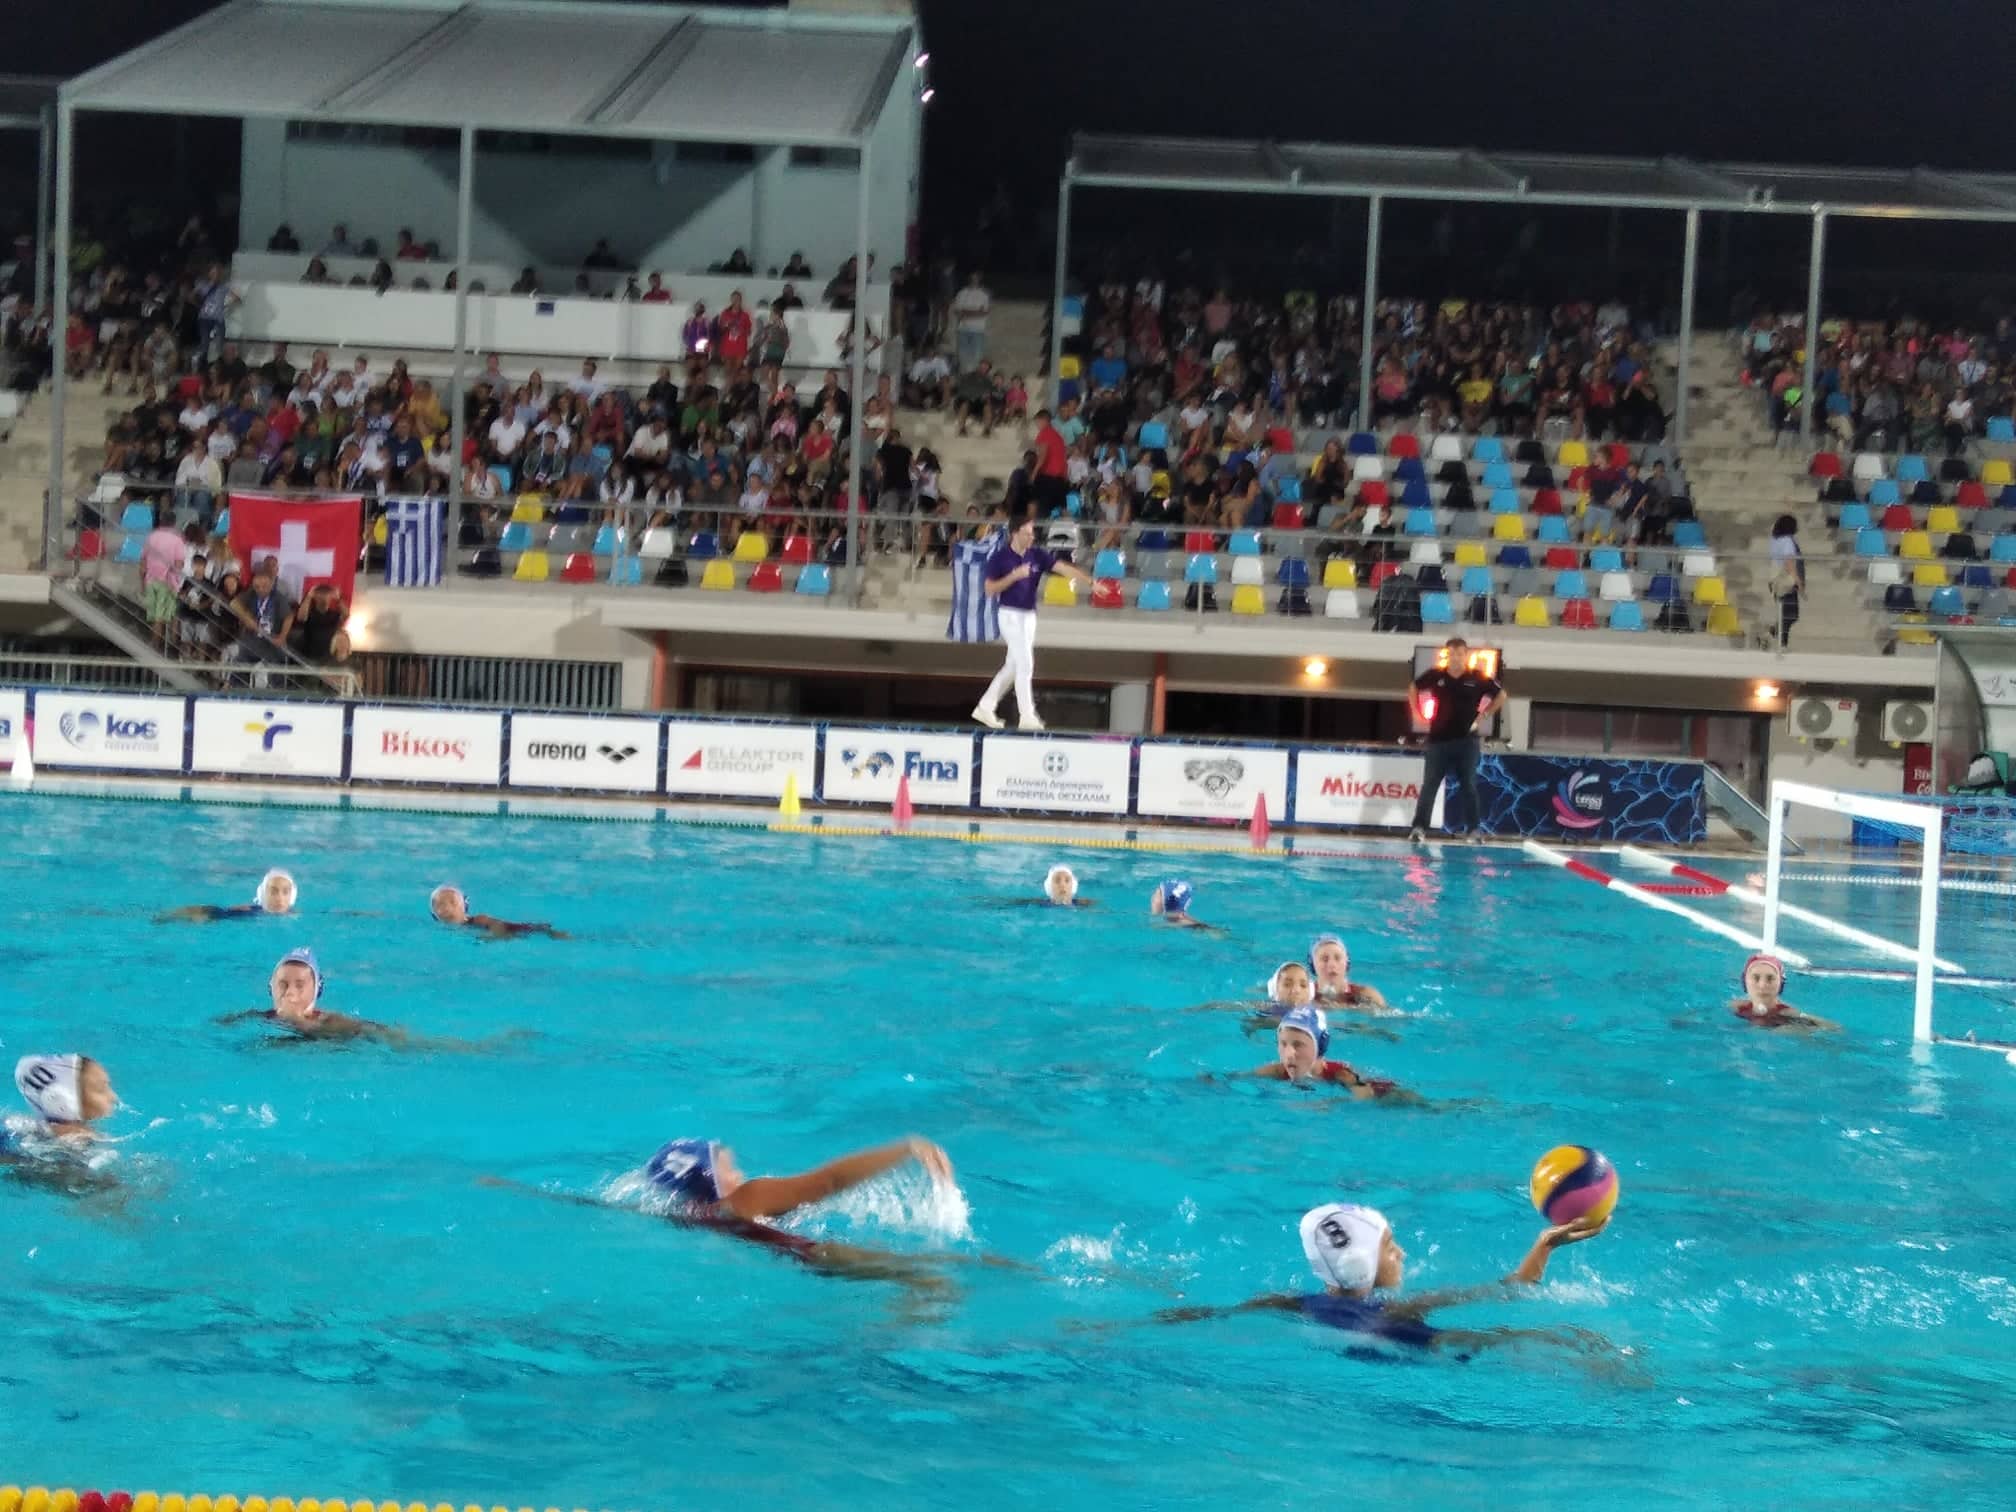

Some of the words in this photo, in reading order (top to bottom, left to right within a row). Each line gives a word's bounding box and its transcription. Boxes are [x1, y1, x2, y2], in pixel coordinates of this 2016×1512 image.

[528, 741, 587, 761] arena
[707, 760, 775, 774] GROUP
[24, 1064, 56, 1091] 10
